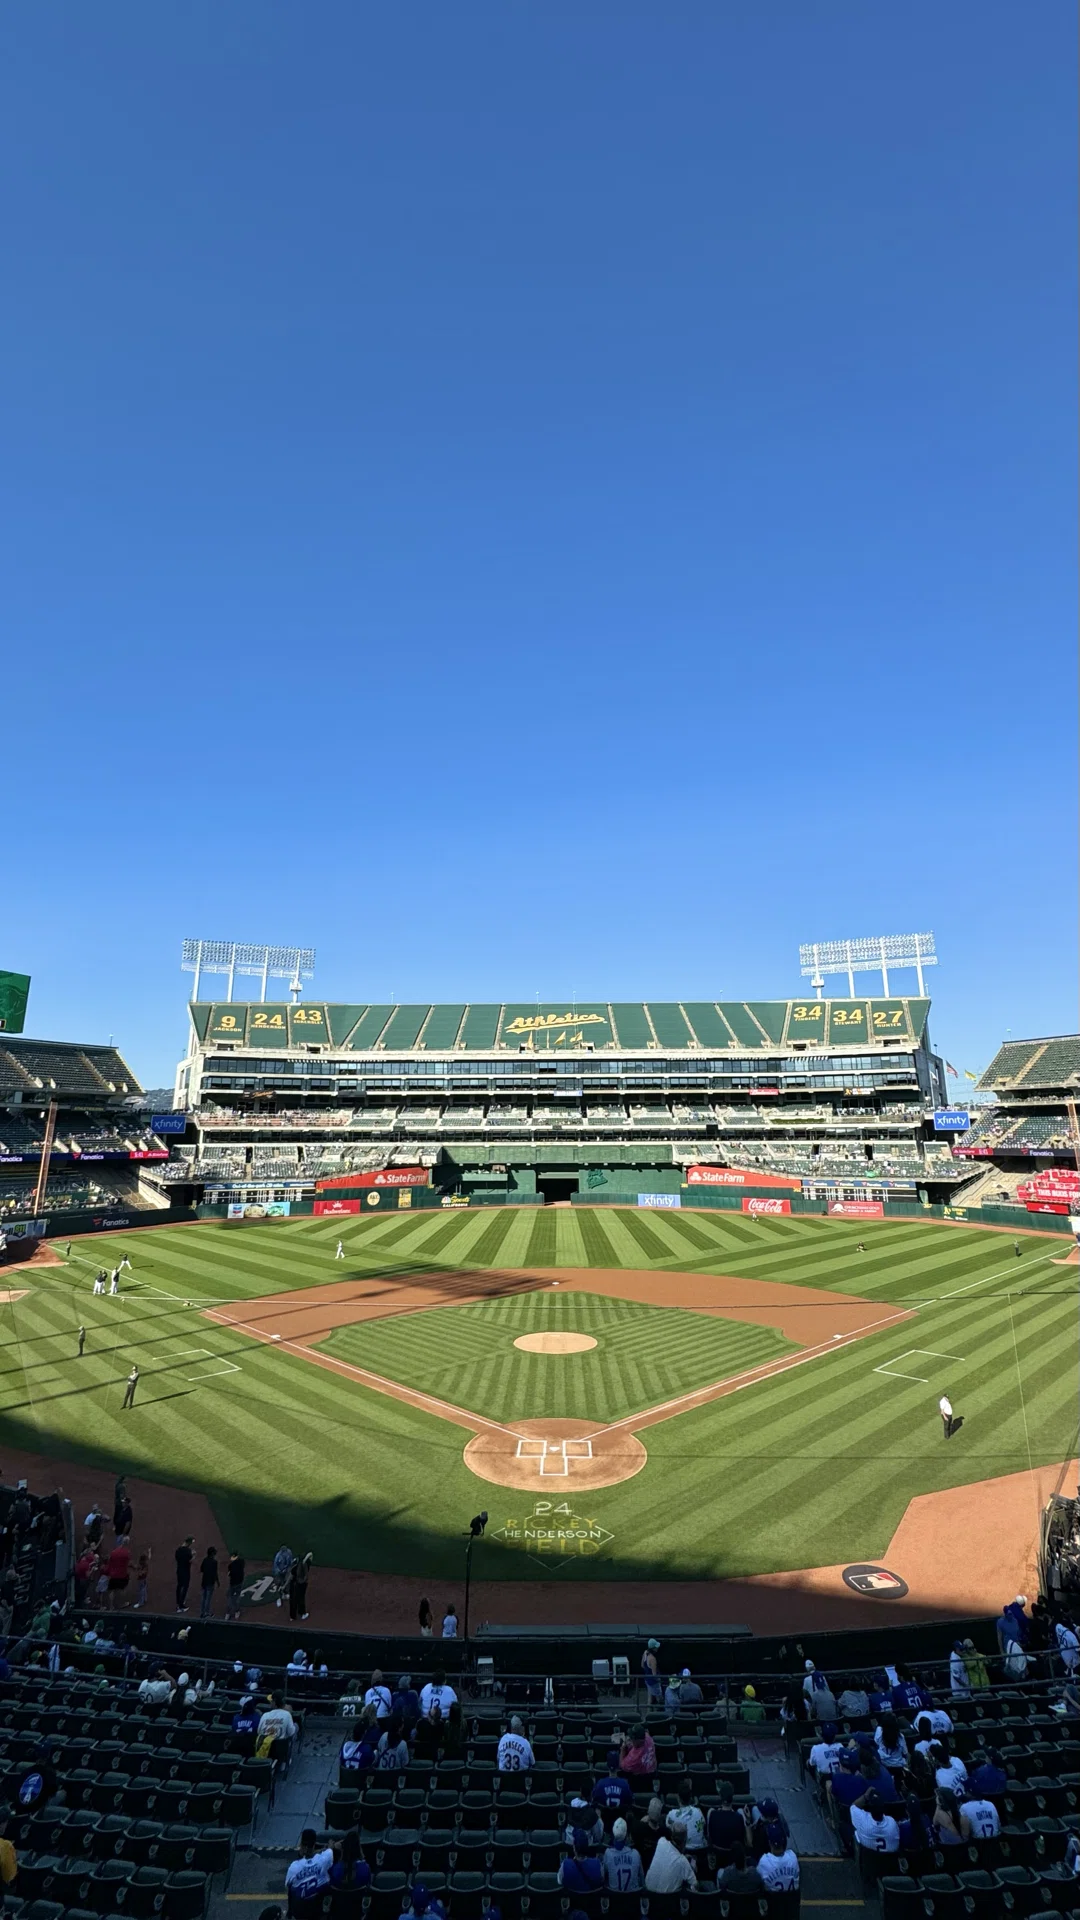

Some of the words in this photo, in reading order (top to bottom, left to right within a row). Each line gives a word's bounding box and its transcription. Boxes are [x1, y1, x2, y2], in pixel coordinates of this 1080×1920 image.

[294, 1010, 322, 1021] 43
[793, 1006, 822, 1018] 34
[833, 1009, 863, 1022] 34
[873, 1011, 903, 1024] 27
[221, 1016, 236, 1028] 9
[254, 1013, 283, 1026] 24
[504, 1013, 605, 1033] Athletics
[154, 1119, 183, 1129] xfinity
[937, 1116, 967, 1126] xfinity
[644, 1196, 673, 1207] xfinity
[748, 1198, 783, 1213] Coca-Cola
[103, 1219, 130, 1227] Fanatics
[535, 1501, 572, 1516] 24
[506, 1518, 597, 1529] RICKEY
[504, 1530, 601, 1539] HENDERSON
[342, 1704, 356, 1717] 23
[502, 1741, 525, 1754] CANSECO
[505, 1753, 520, 1770] 33
[981, 1824, 994, 1838] 17
[613, 1854, 633, 1865] OHTANI
[617, 1868, 631, 1891] 17
